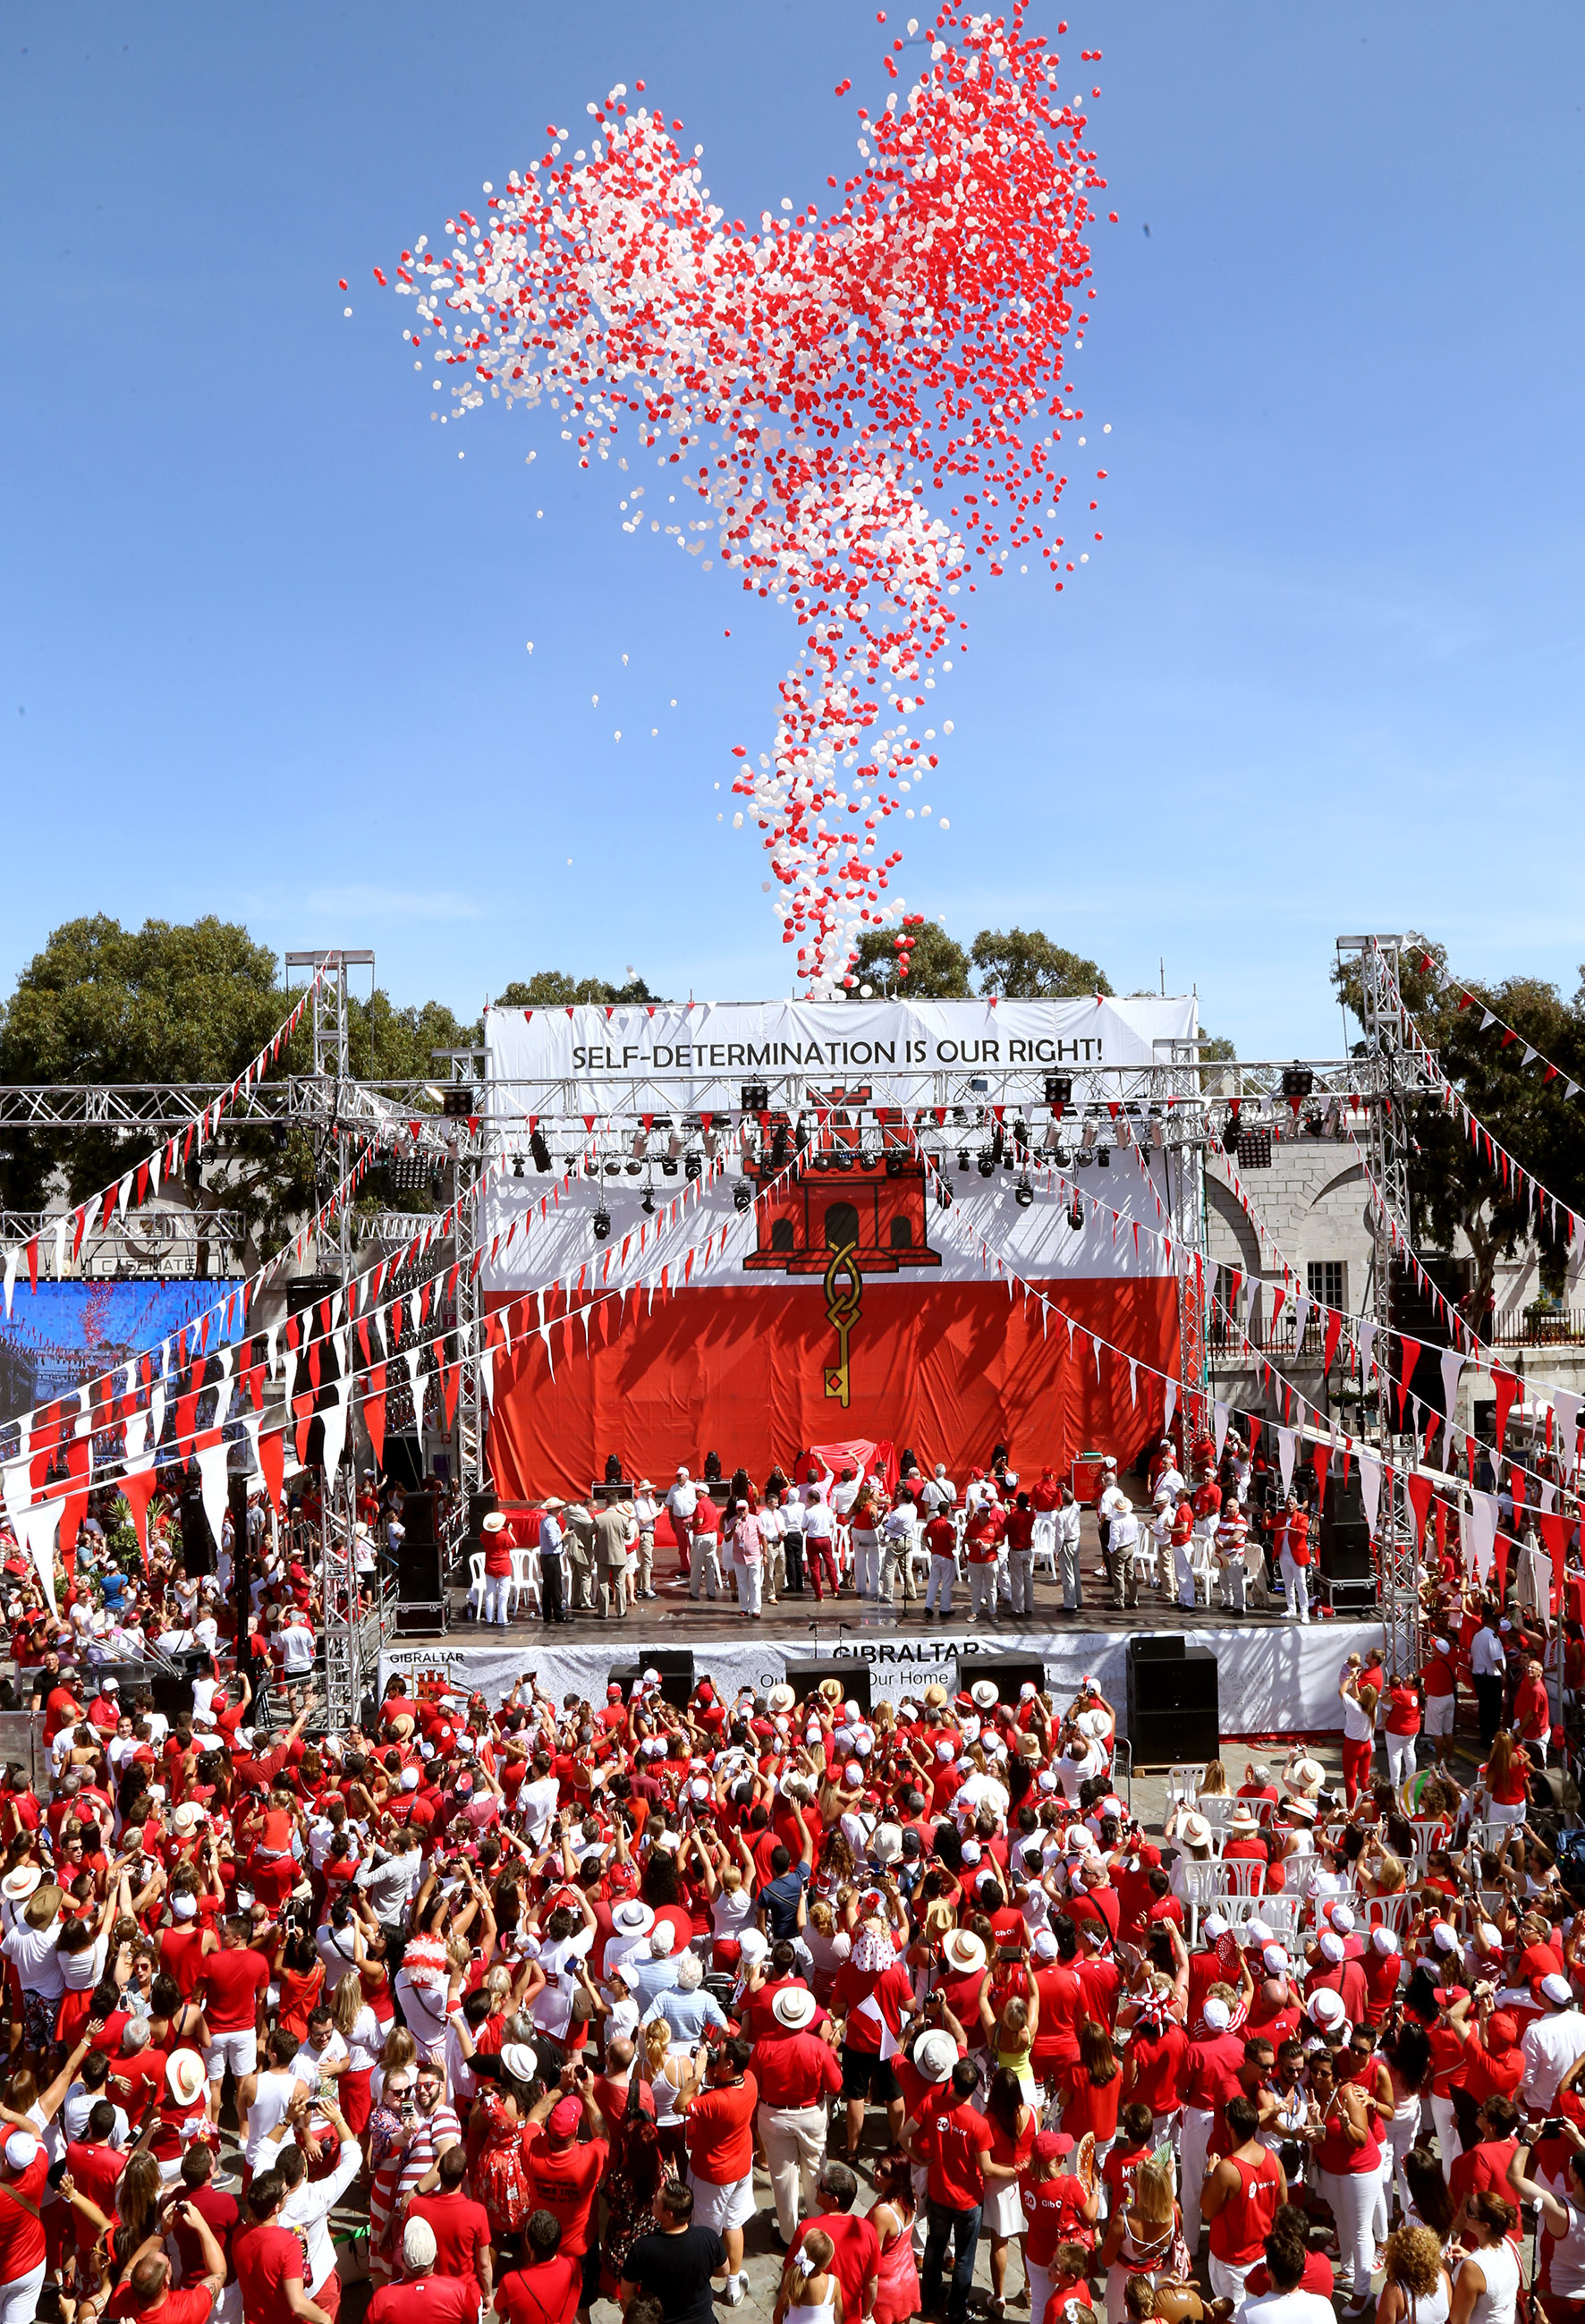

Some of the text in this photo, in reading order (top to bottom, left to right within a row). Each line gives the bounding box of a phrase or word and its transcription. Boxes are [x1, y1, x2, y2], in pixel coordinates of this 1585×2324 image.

[573, 1039, 1103, 1069] SELF-DETERMINATION IS OUR RIGHT!
[102, 1259, 196, 1273] CASEMATE
[390, 1652, 464, 1663] GIBRALTAR
[833, 1642, 979, 1663] GIBRALTAR
[901, 1671, 948, 1685] Home
[1041, 2200, 1055, 2209] Gib
